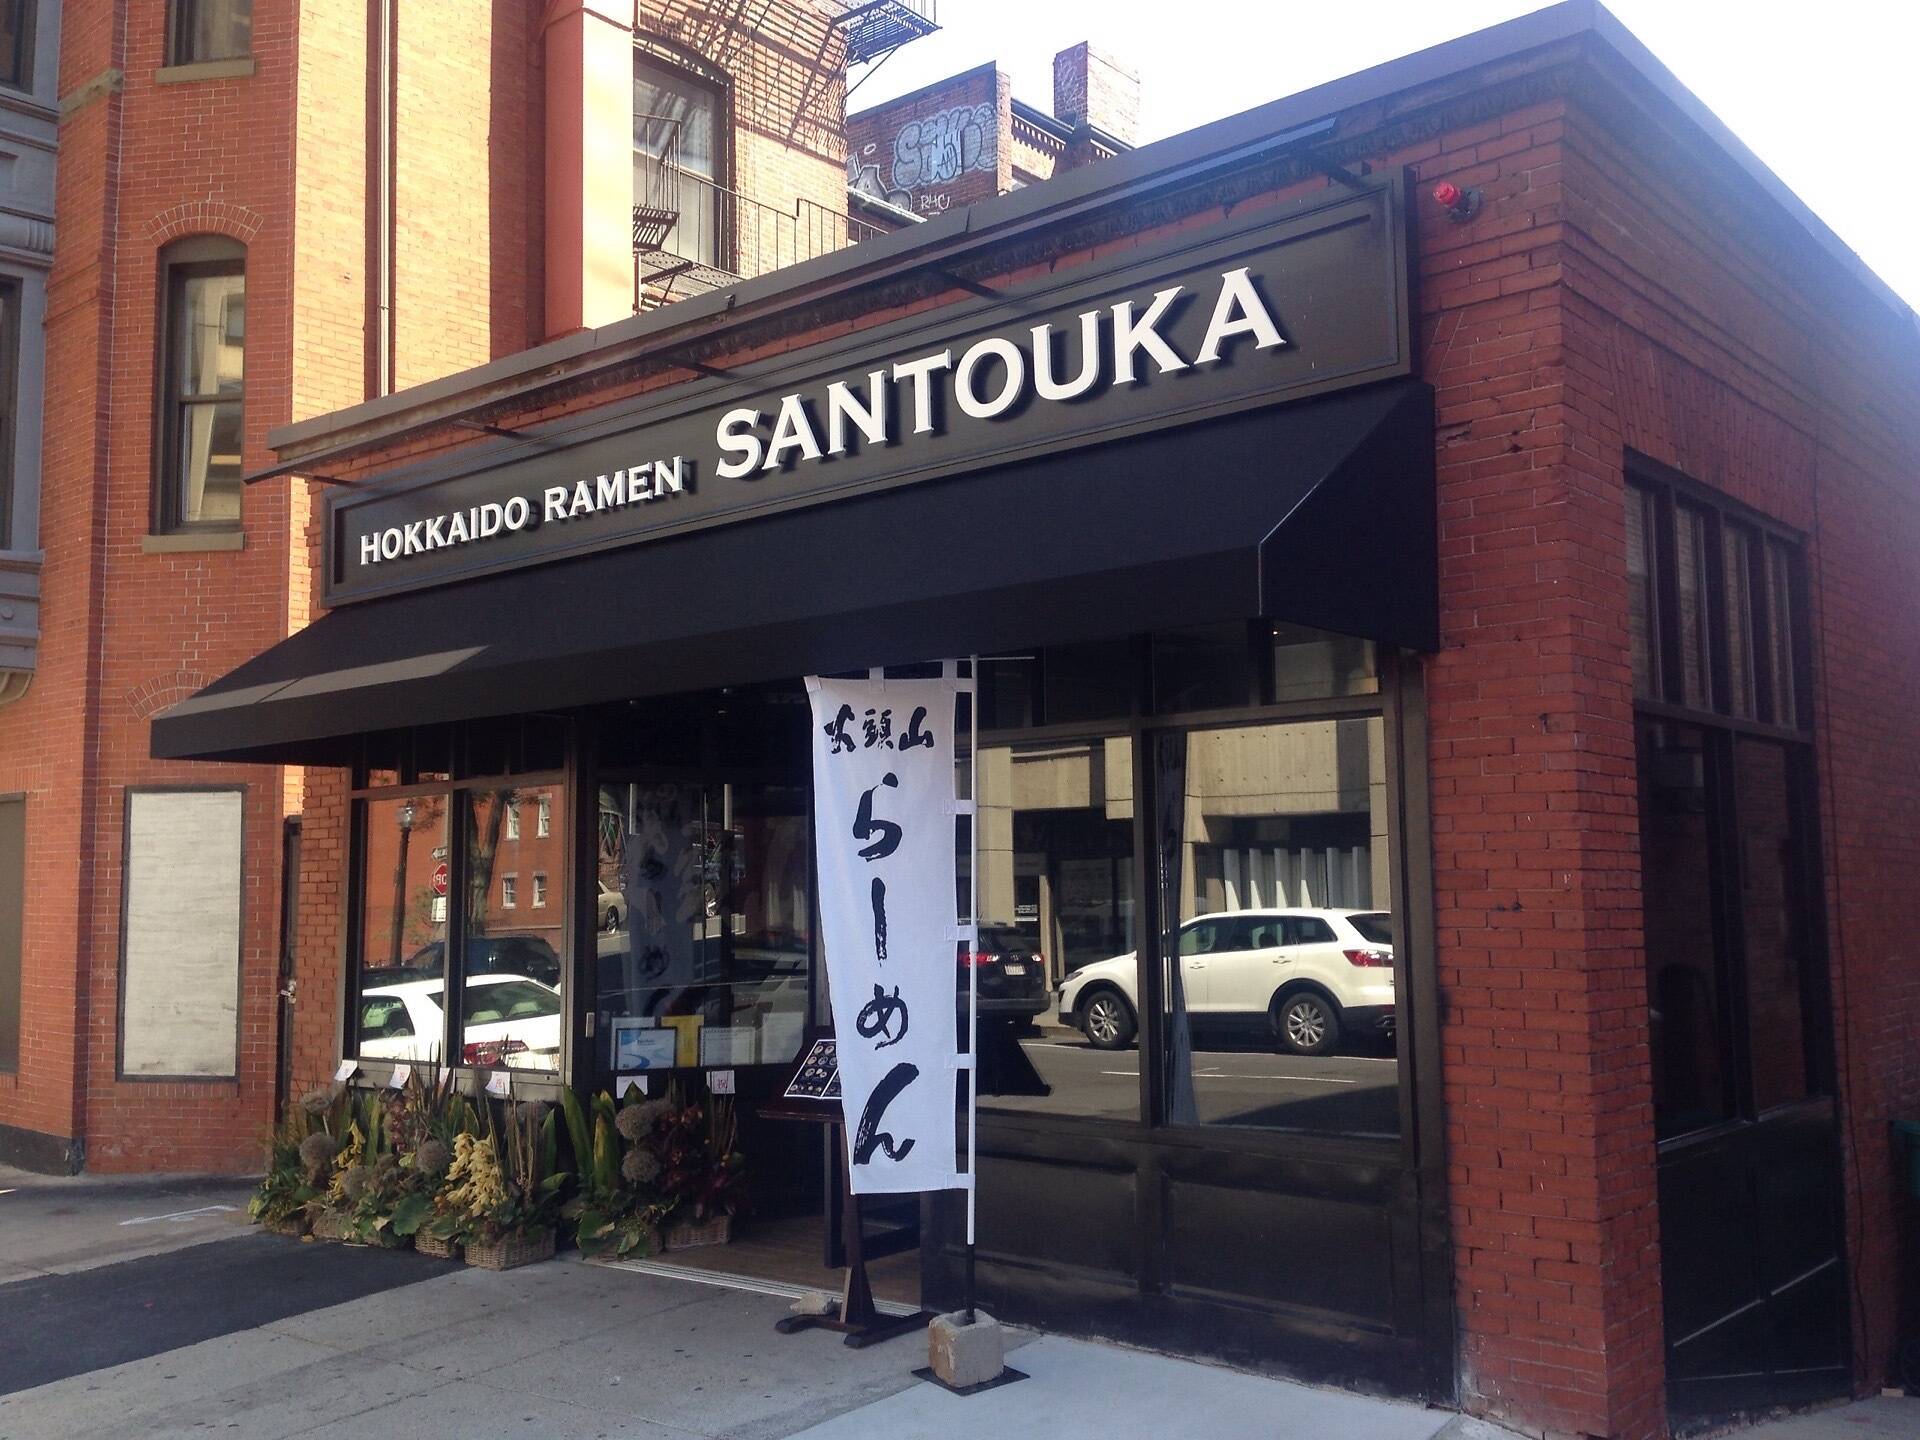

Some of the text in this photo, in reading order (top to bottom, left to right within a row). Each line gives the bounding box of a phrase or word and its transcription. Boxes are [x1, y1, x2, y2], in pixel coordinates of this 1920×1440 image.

[360, 266, 1287, 566] HOKKAIDO RAMEN SANTOUKA
[852, 772, 920, 1166] らーめん
